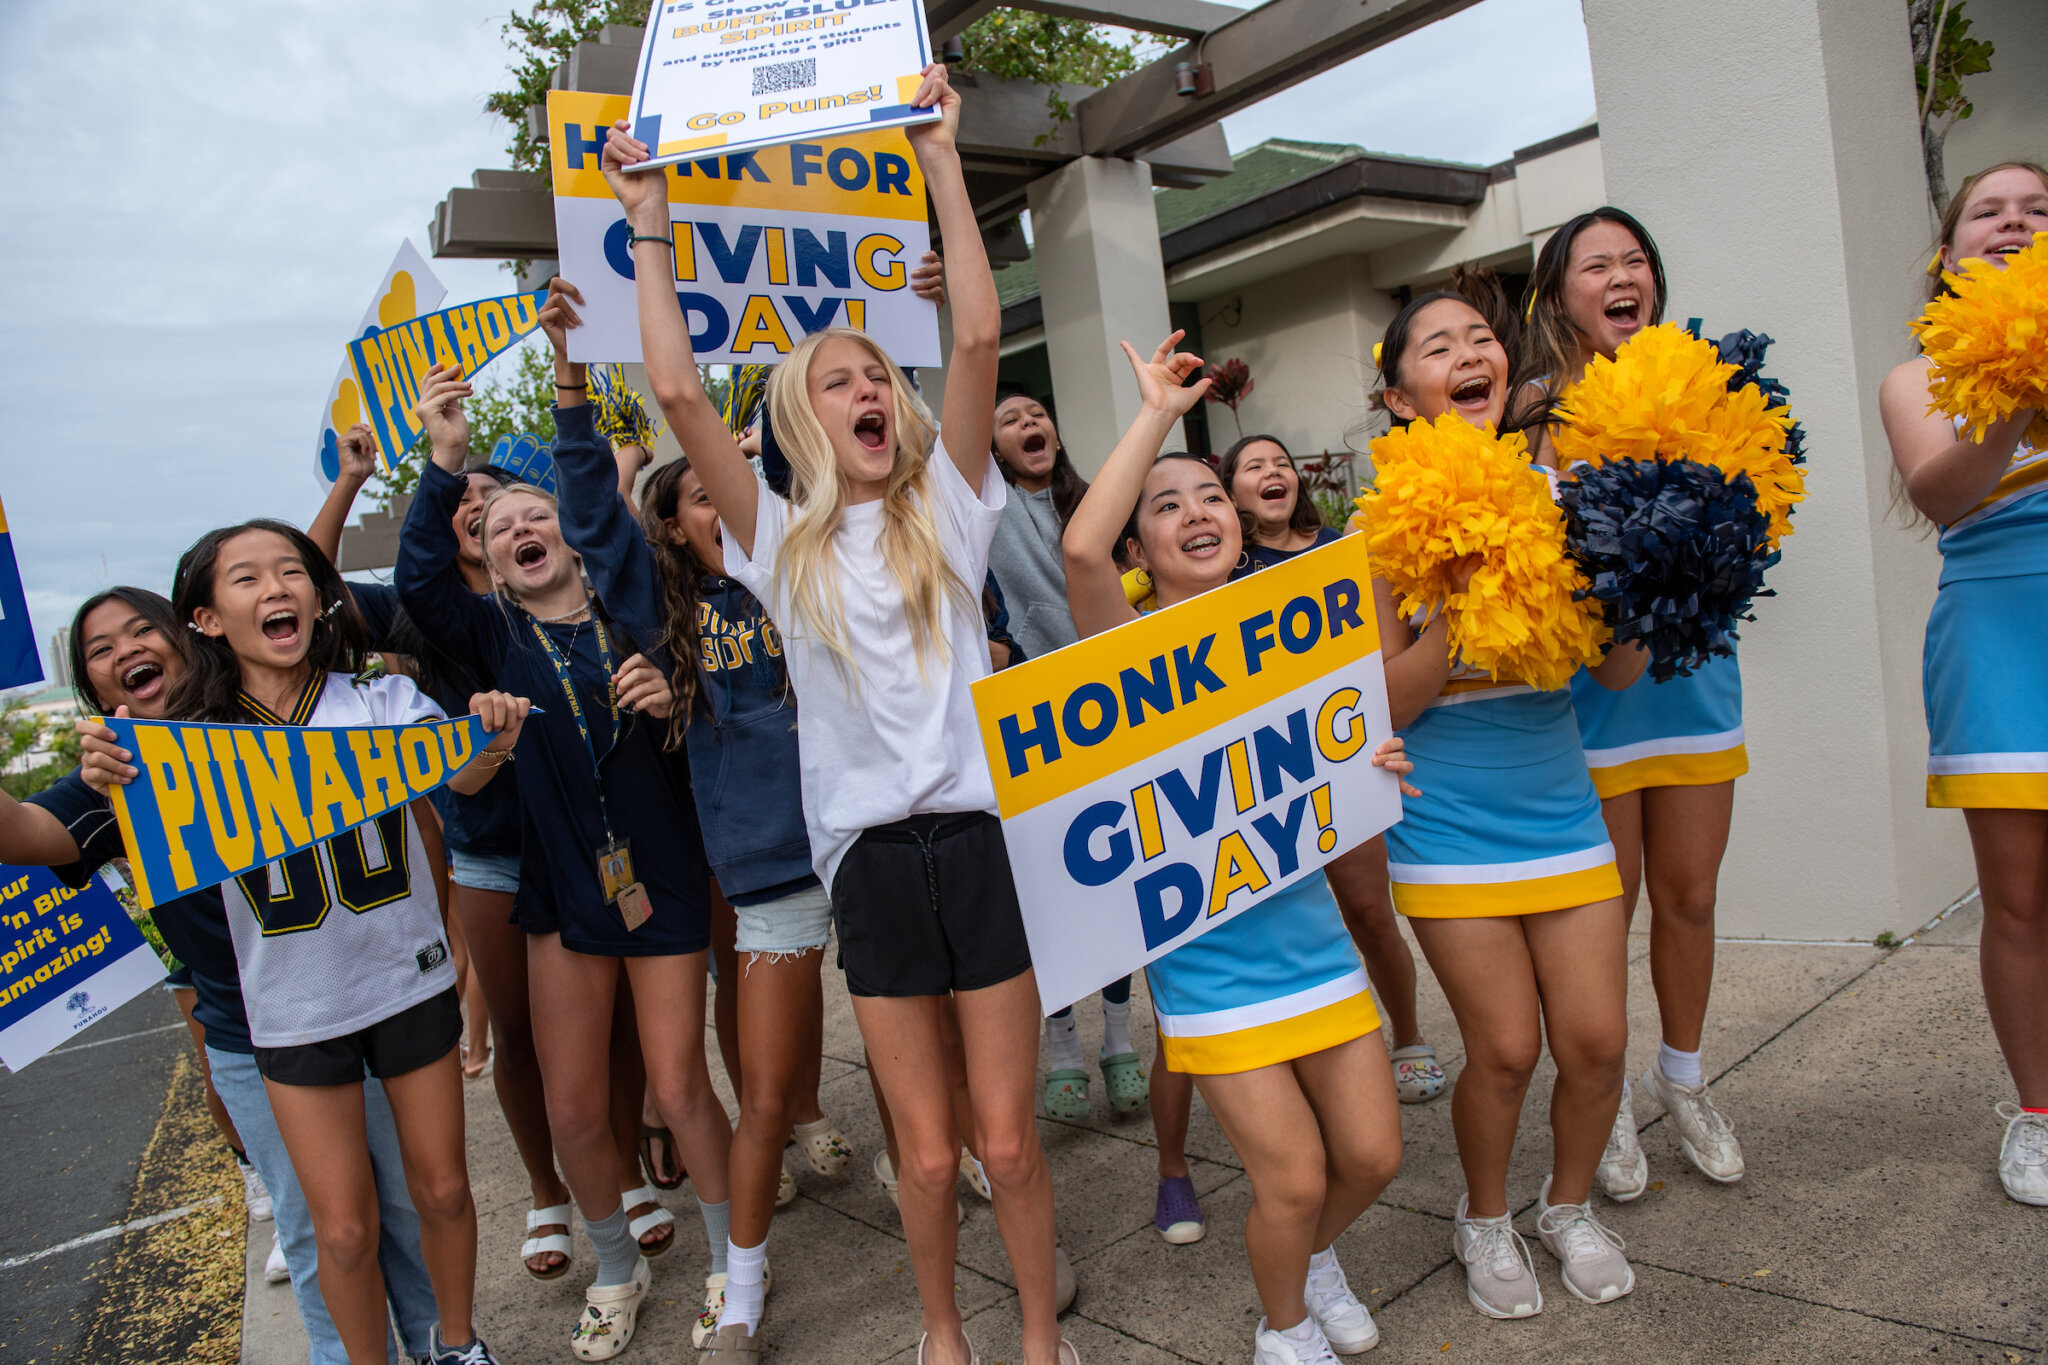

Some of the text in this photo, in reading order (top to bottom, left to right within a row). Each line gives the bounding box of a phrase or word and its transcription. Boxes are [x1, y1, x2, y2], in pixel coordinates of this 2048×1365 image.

[667, 2, 694, 14] IS
[672, 11, 777, 39] BUFF
[707, 0, 789, 20] Show
[719, 12, 851, 45] SPIRIT
[662, 22, 902, 66] and support our students
[701, 59, 725, 68] by
[729, 46, 800, 63] making
[823, 36, 862, 48] gift!
[686, 85, 883, 130] Go Puns!
[564, 123, 913, 196] HK FOR
[603, 218, 907, 292] GIVING
[360, 294, 538, 459] PUNAHOU
[532, 623, 554, 653] PUNAHOU
[561, 677, 581, 717] PUNAHOU
[998, 578, 1366, 779] HONK FOR
[134, 719, 474, 893] PUNAHOU
[1063, 686, 1368, 887] GIVING
[1134, 781, 1338, 952] DAY!
[0, 912, 83, 975] pirit is
[0, 925, 112, 1008] amazing!
[73, 1006, 109, 1030] PUNAHOU
